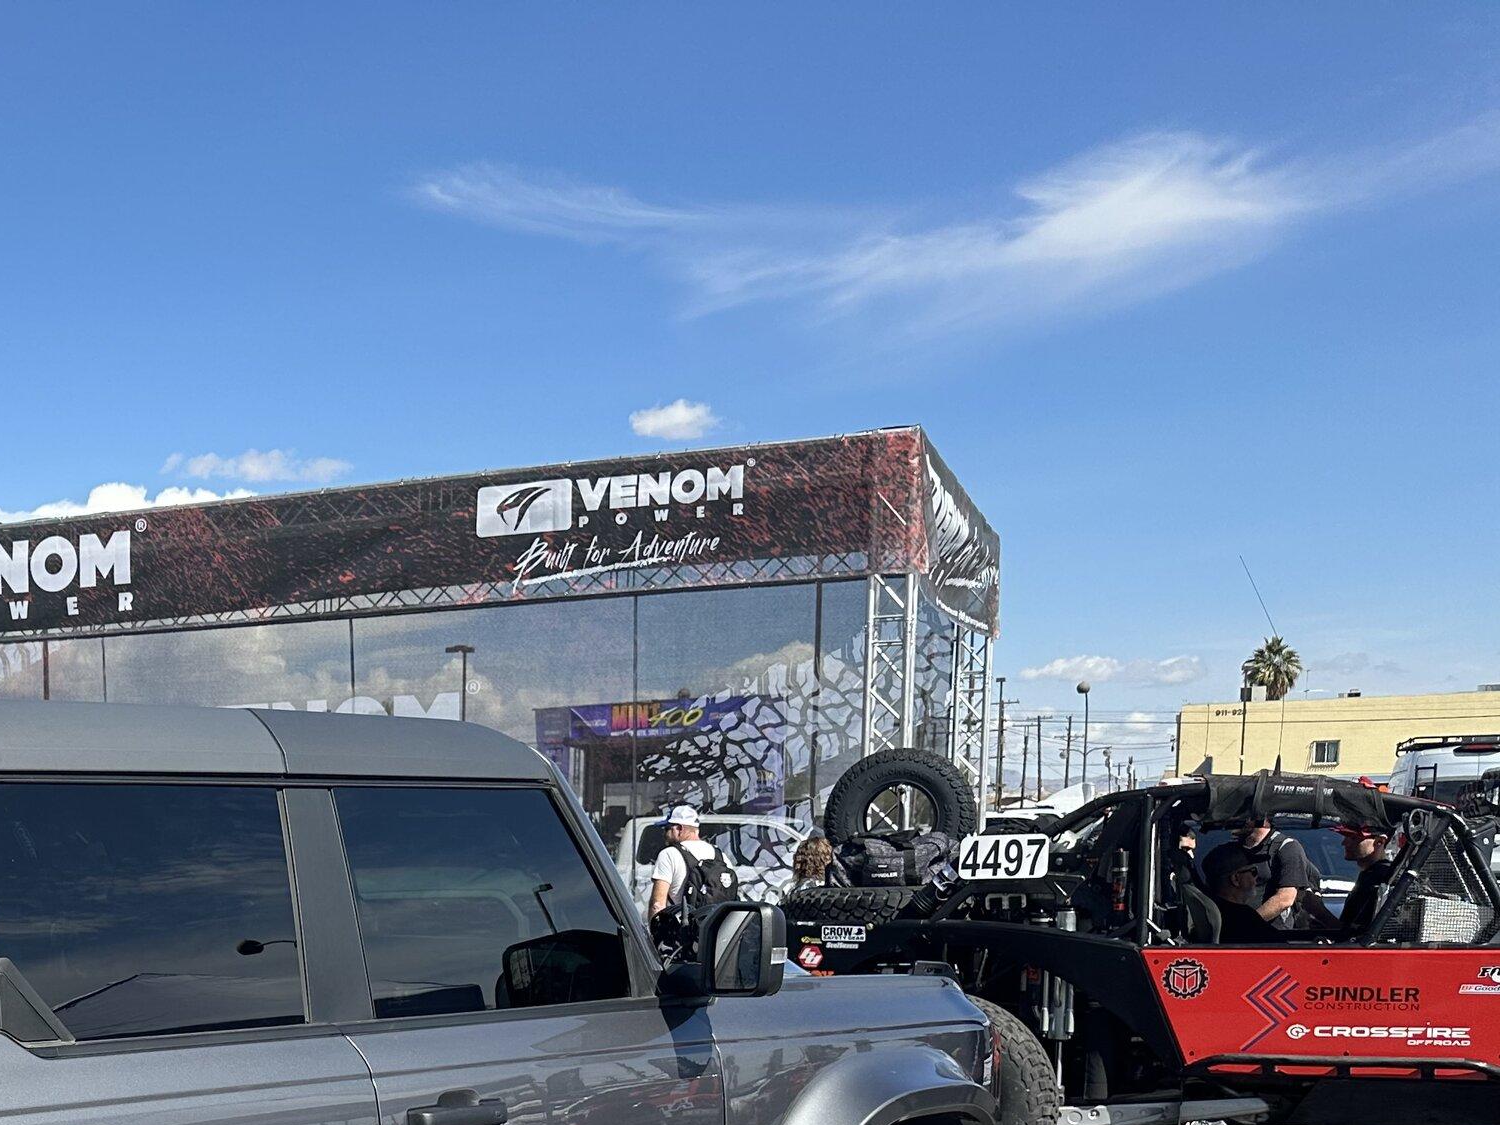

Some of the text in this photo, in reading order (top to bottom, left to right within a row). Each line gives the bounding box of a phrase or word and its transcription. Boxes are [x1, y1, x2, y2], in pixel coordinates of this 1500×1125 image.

[576, 465, 744, 512] VENOM
[578, 503, 744, 529] POWER
[512, 530, 721, 594] Built for Adventure
[960, 838, 1047, 877] 4497
[823, 927, 853, 936] CROW
[1304, 986, 1420, 1002] SPINDLER
[1303, 1002, 1420, 1012] CONSTRUCTION
[1313, 1022, 1471, 1039] CROSSFIRE
[1406, 1039, 1471, 1047] OFFROAD
